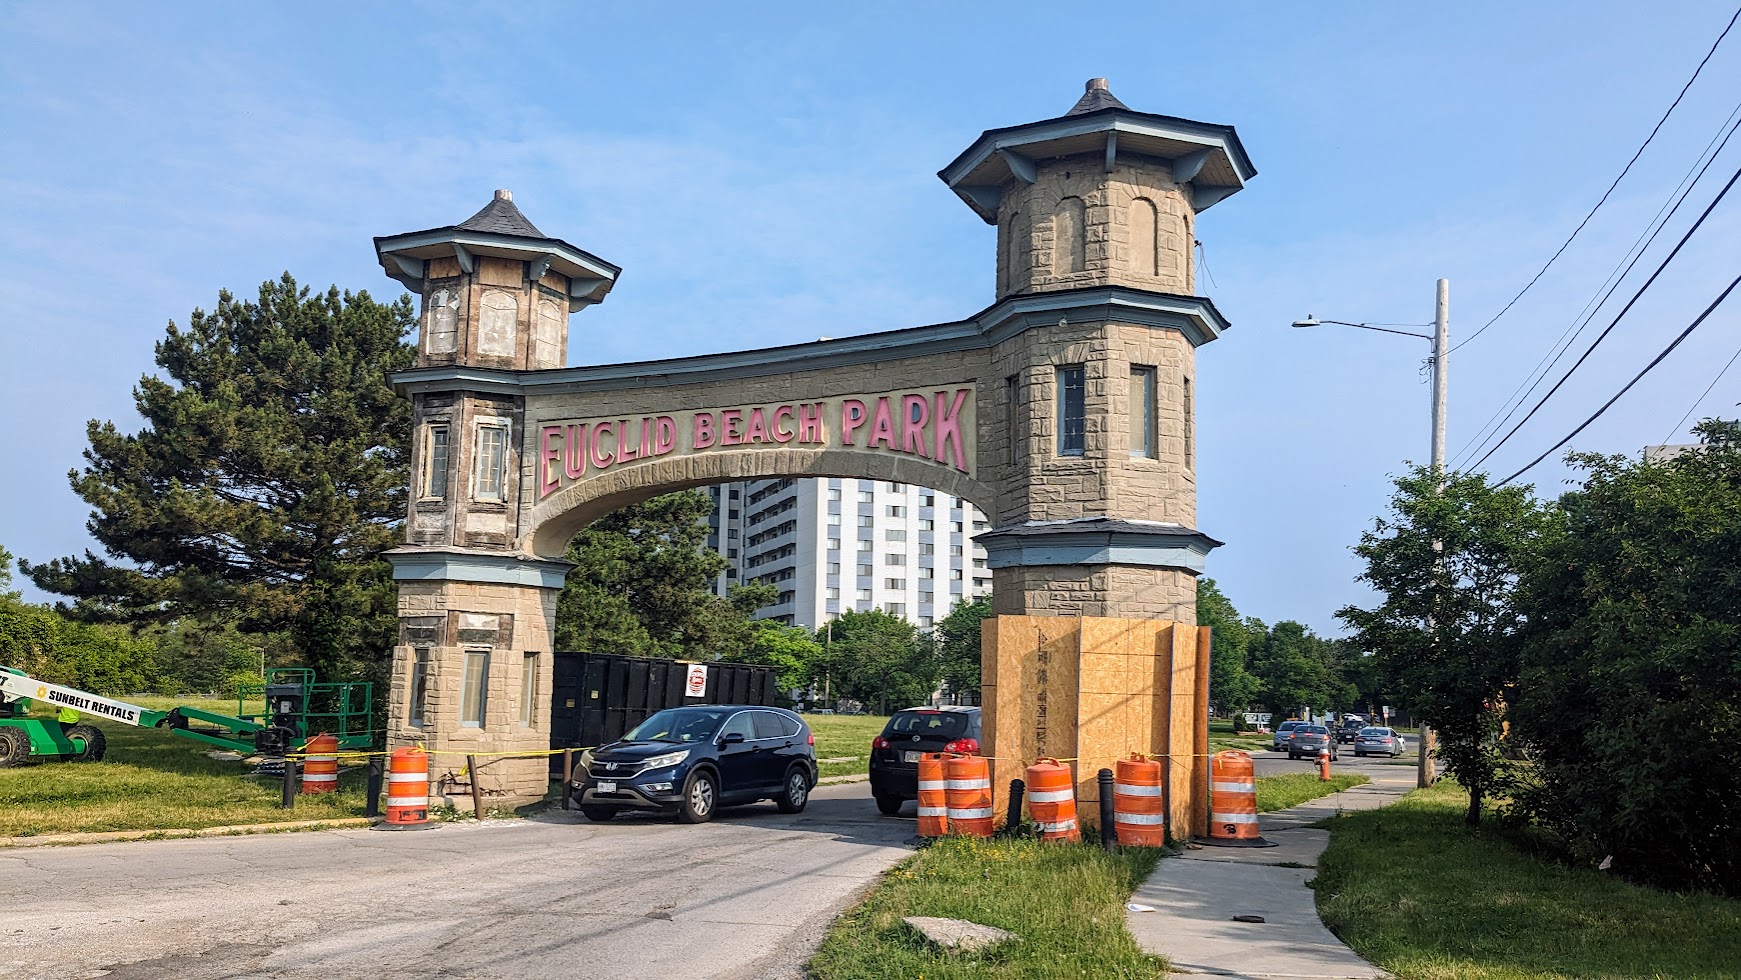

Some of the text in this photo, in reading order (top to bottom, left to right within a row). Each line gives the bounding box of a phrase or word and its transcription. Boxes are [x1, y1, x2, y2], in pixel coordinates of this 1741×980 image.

[540, 388, 970, 498] EUCLID BEACH PARK
[48, 690, 135, 721] SUNBELT RENTALS
